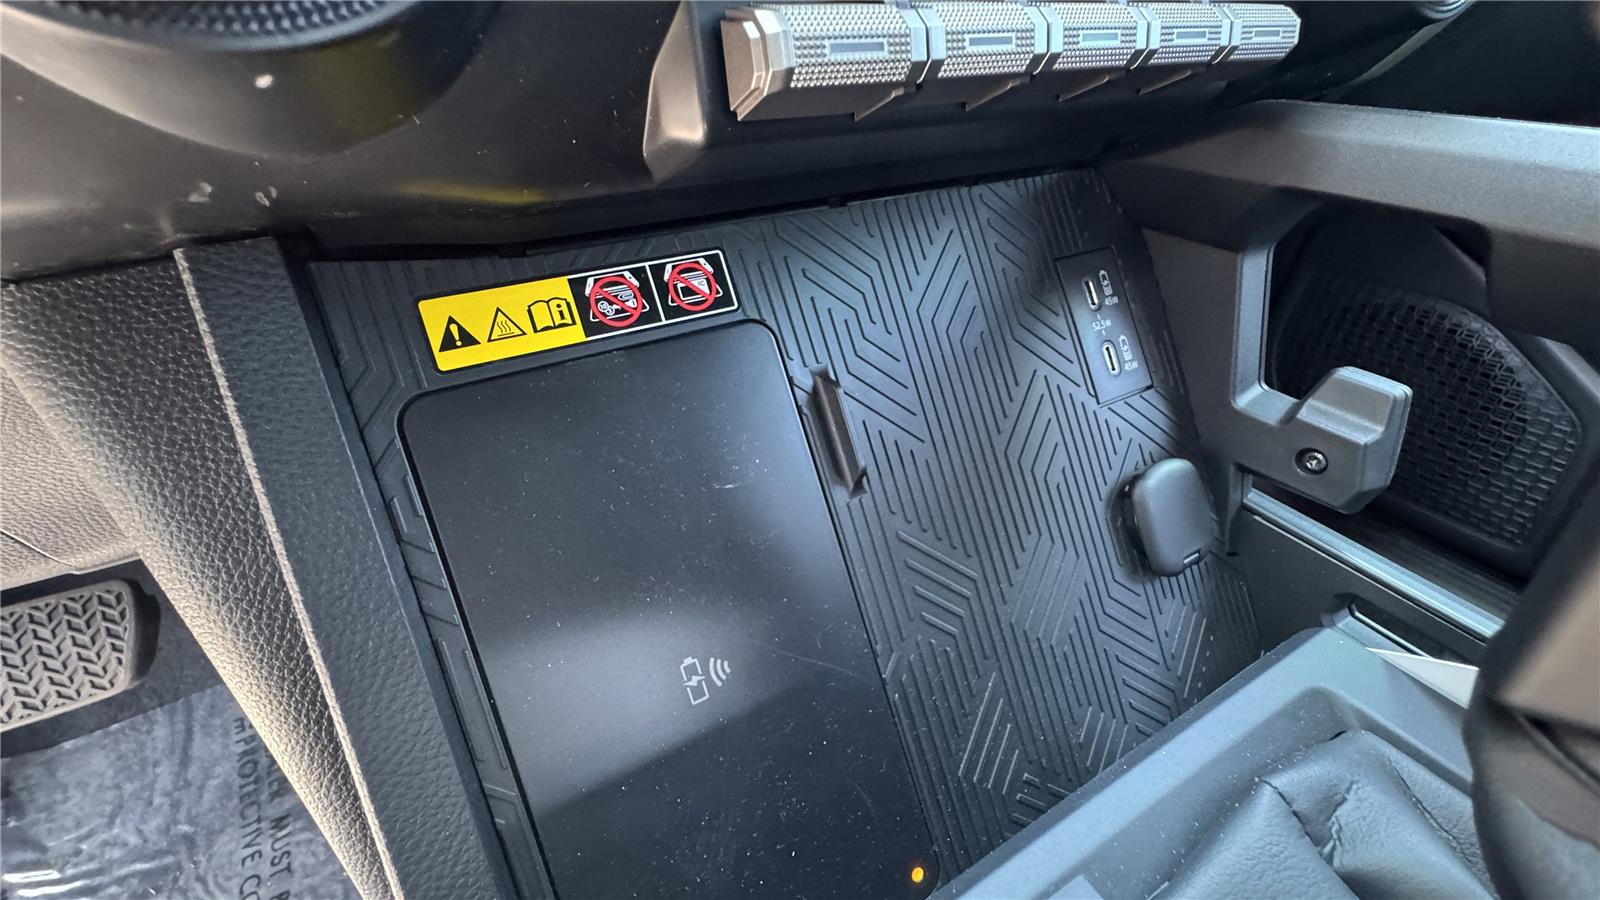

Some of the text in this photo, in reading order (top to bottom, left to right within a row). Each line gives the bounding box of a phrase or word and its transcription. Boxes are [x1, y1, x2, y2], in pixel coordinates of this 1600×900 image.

[1105, 296, 1119, 306] 45W
[1124, 362, 1139, 371] 45W
[235, 735, 263, 868] PROTECTIVE
[269, 814, 293, 878] MUST
